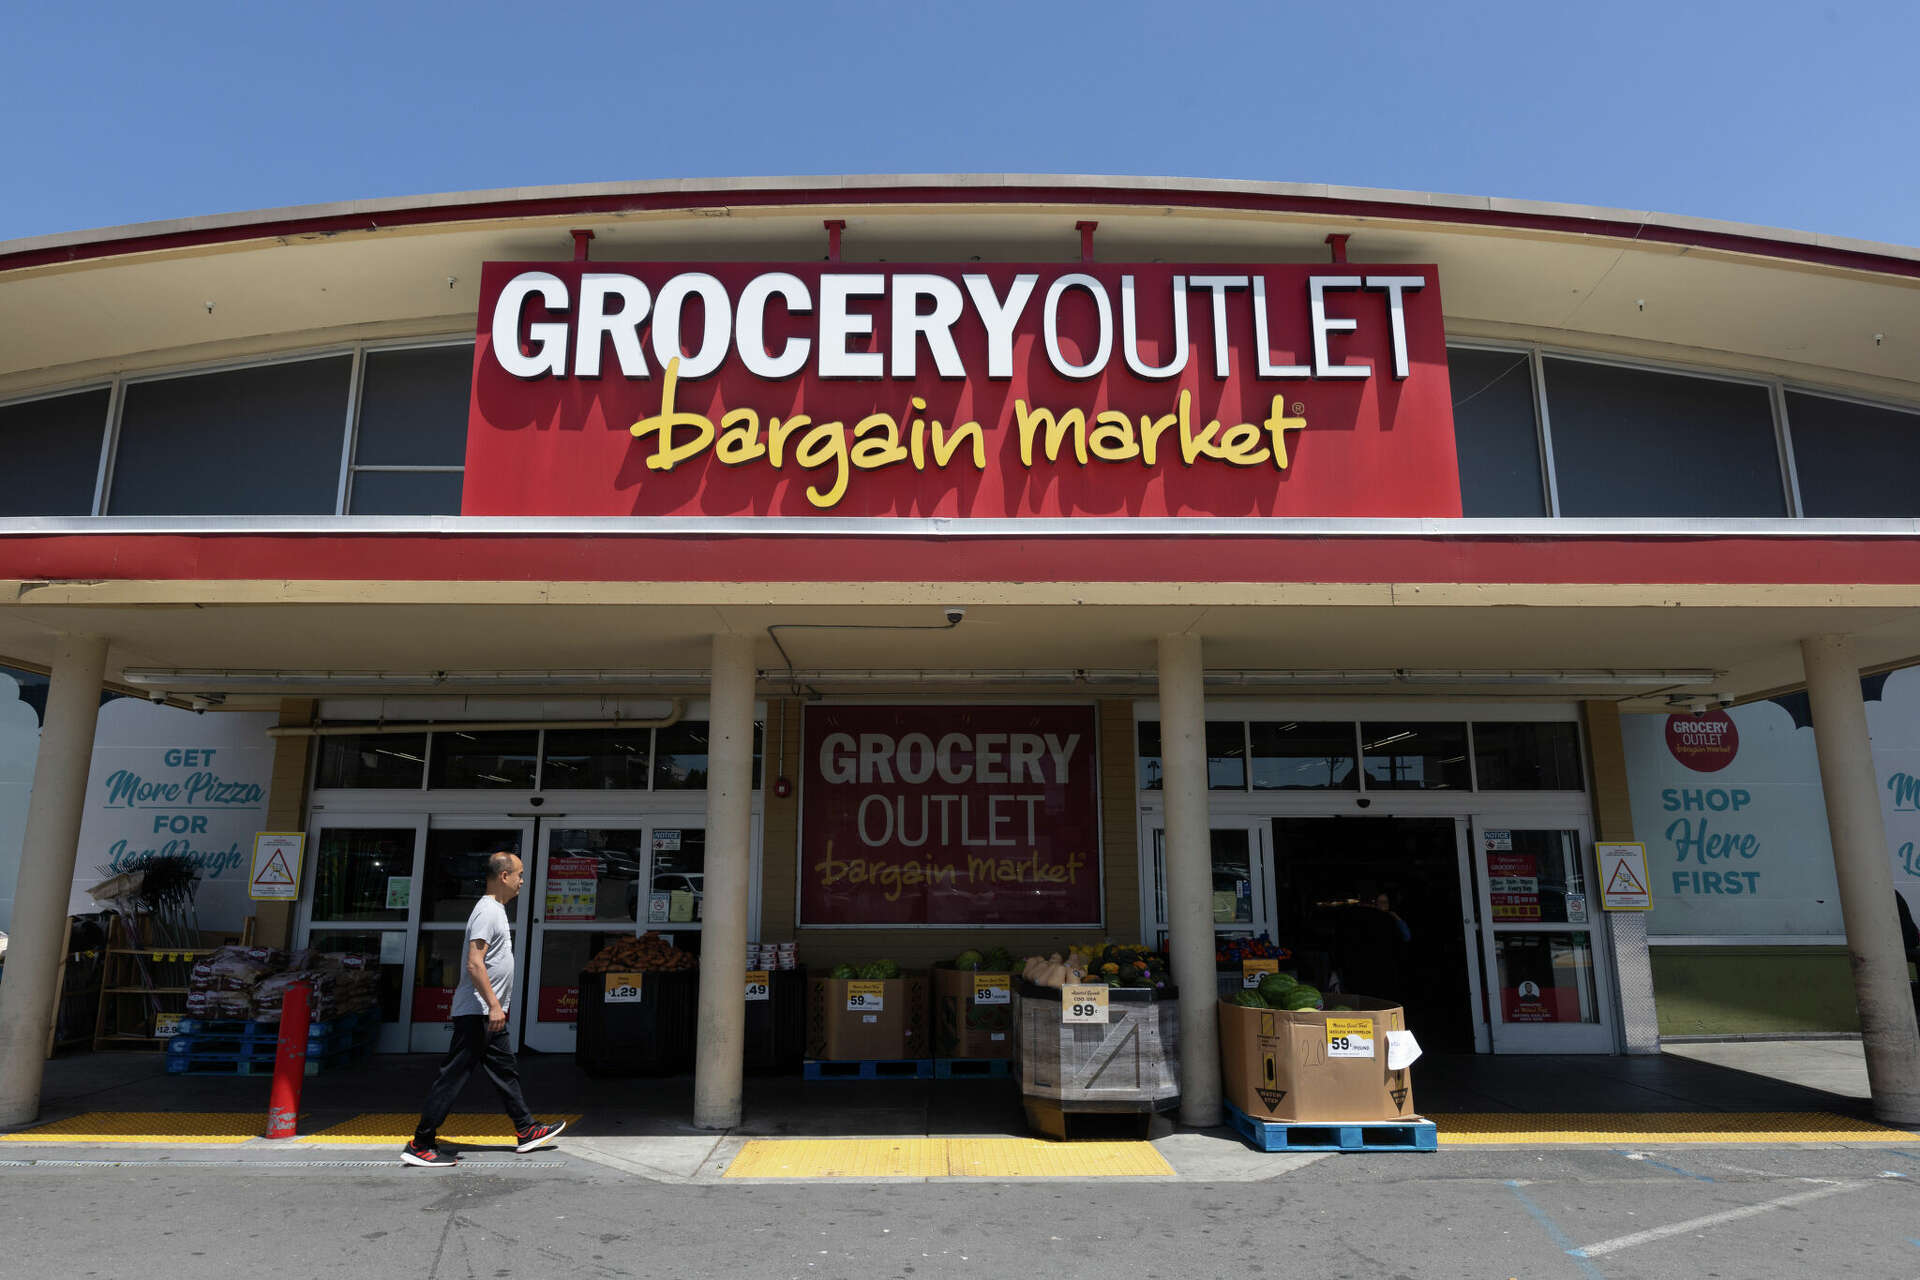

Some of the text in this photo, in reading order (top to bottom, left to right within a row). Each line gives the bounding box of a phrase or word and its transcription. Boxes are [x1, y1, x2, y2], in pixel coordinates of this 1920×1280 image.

[630, 356, 986, 508] bargain
[1673, 721, 1728, 734] GROCERY
[1683, 734, 1722, 745] OUTLET
[164, 748, 217, 767] GET
[818, 732, 1080, 784] GROCERY
[106, 769, 266, 807] More Pizza
[1662, 788, 1751, 812] SHOP
[153, 815, 209, 834] FOR
[858, 794, 1045, 847] OUTLET
[1485, 832, 1510, 840] NOTICE
[1665, 817, 1761, 865] Here
[814, 839, 957, 902] bargain
[1672, 871, 1760, 894] FIRST
